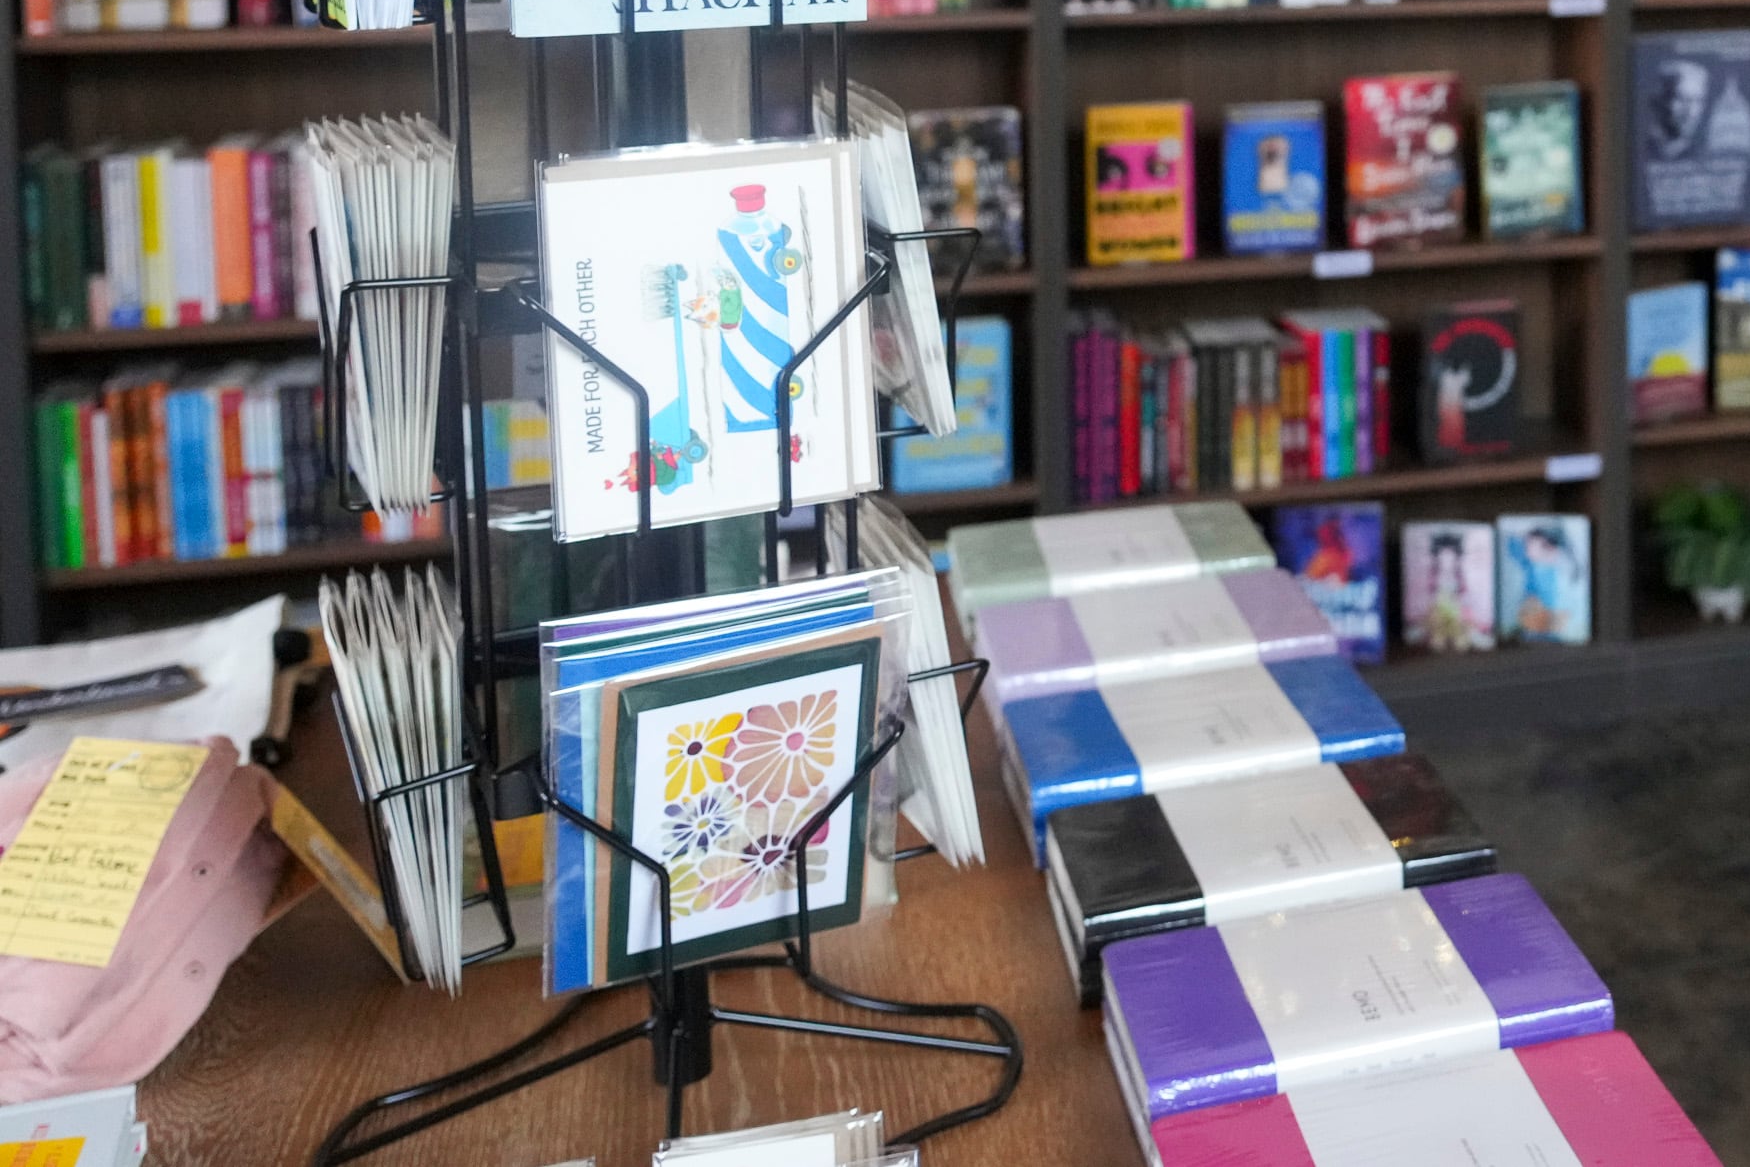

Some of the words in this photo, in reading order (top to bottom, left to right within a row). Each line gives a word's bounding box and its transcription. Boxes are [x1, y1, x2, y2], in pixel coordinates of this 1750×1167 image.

[576, 257, 595, 314] OTHER
[582, 367, 602, 405] FOR
[585, 405, 605, 454] MADE
